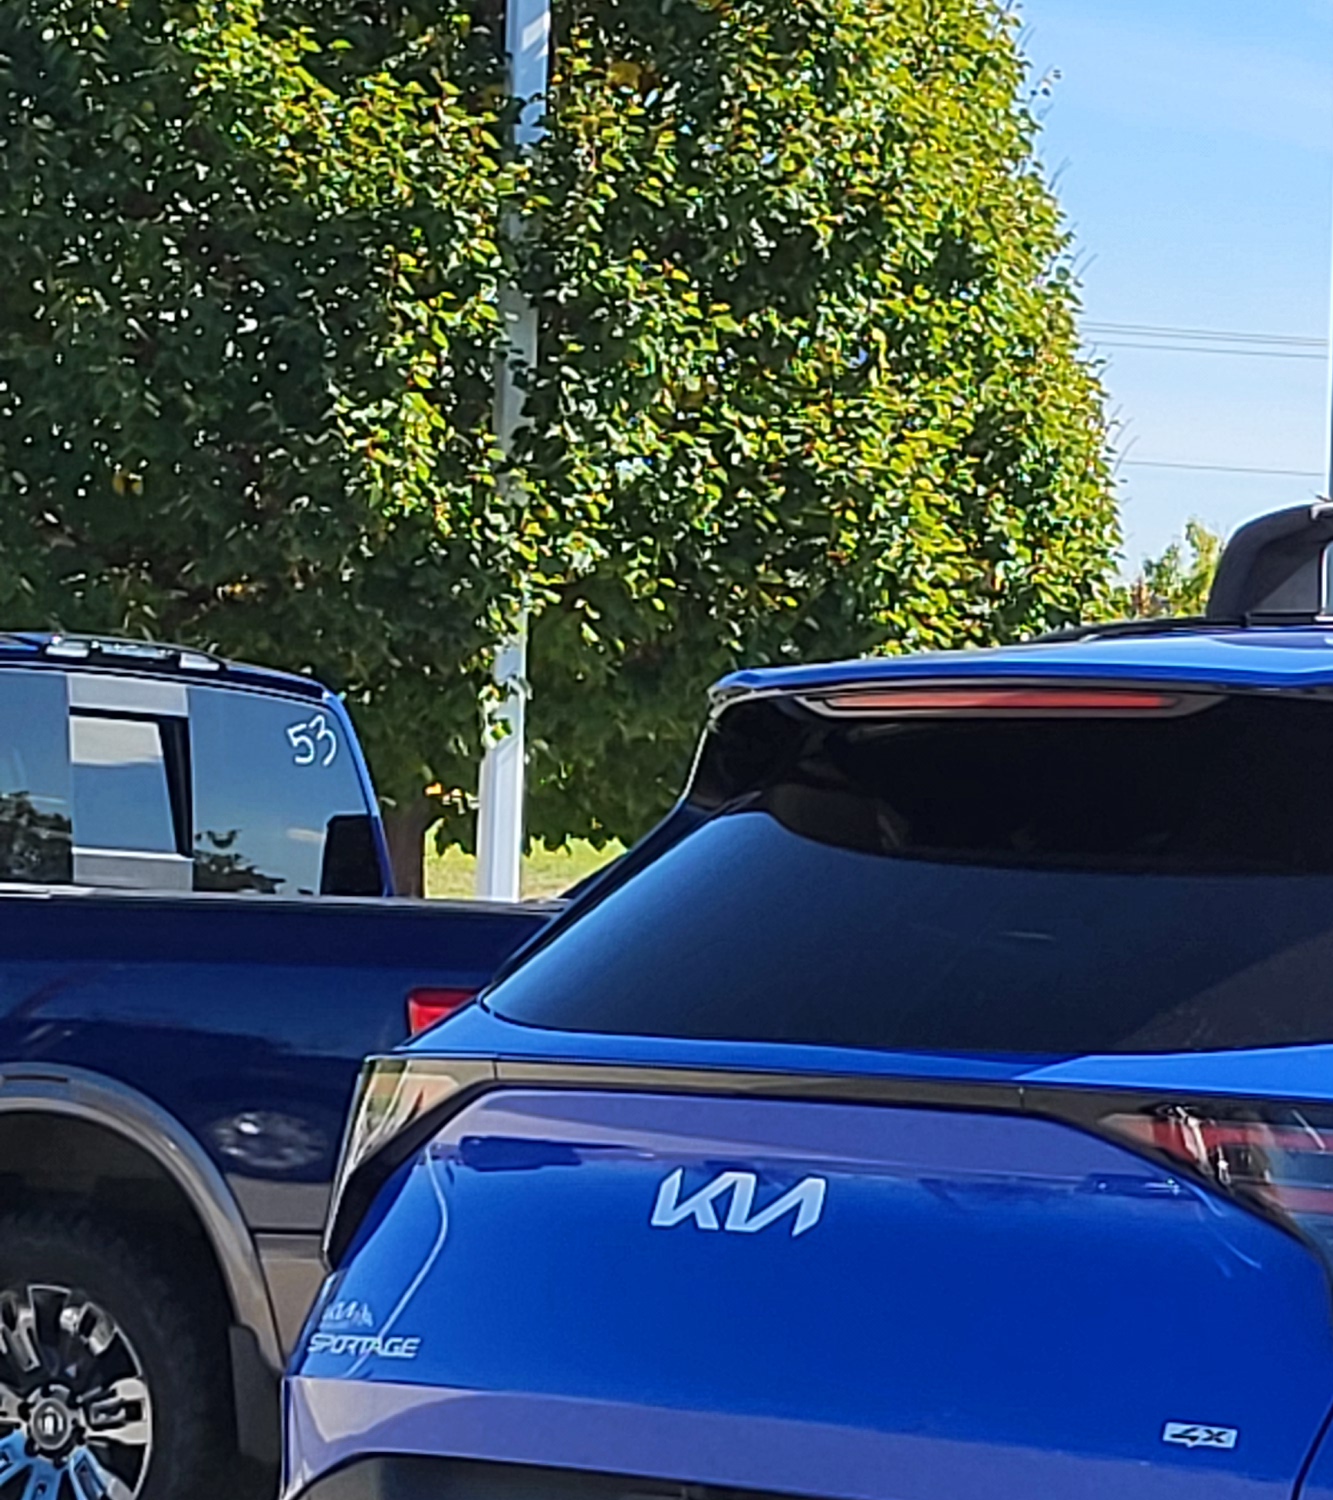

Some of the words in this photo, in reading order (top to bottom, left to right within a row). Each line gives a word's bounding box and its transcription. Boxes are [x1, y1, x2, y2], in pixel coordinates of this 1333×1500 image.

[287, 714, 337, 766] 53
[651, 1168, 826, 1237] KIA
[308, 1333, 420, 1358] SPORTAGE
